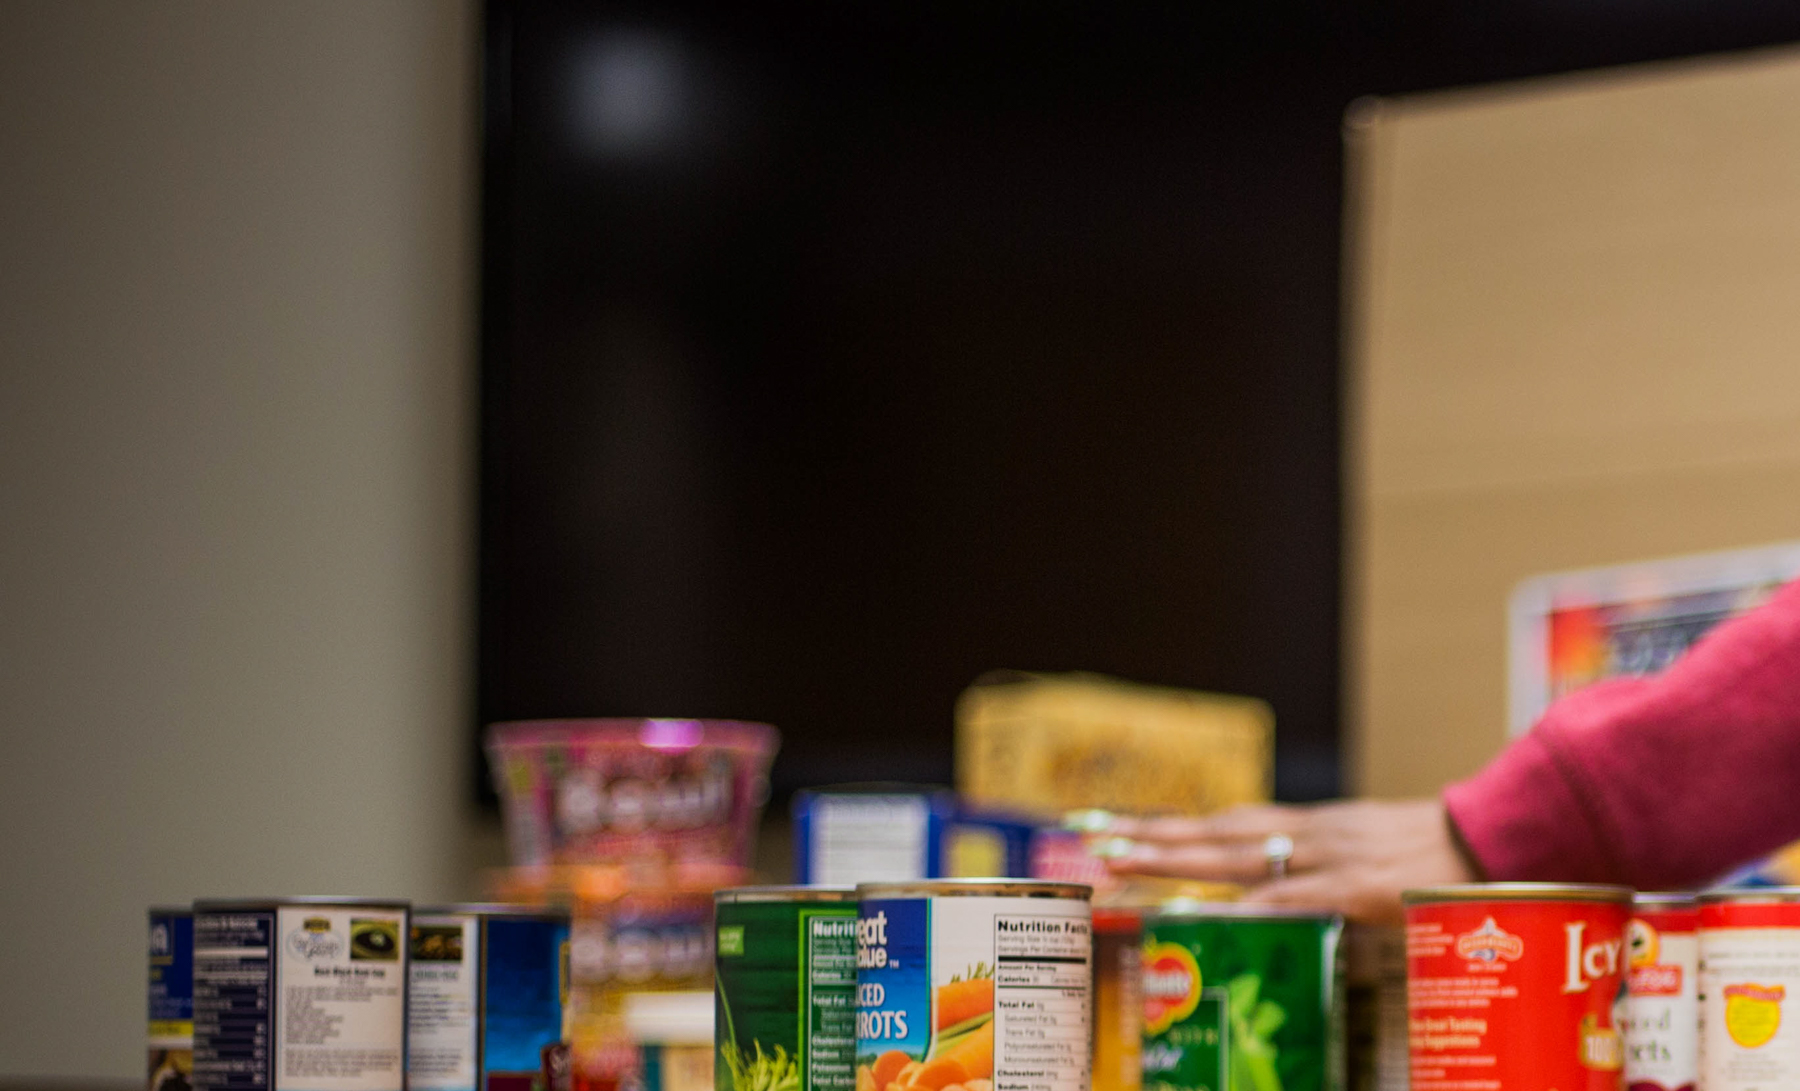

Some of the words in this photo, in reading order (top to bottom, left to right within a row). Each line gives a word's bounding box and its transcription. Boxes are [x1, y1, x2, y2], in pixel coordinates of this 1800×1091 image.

[998, 921, 1061, 933] Nutrition
[1065, 922, 1088, 935] Facts
[998, 975, 1030, 983] Calories
[856, 983, 886, 1007] ICED
